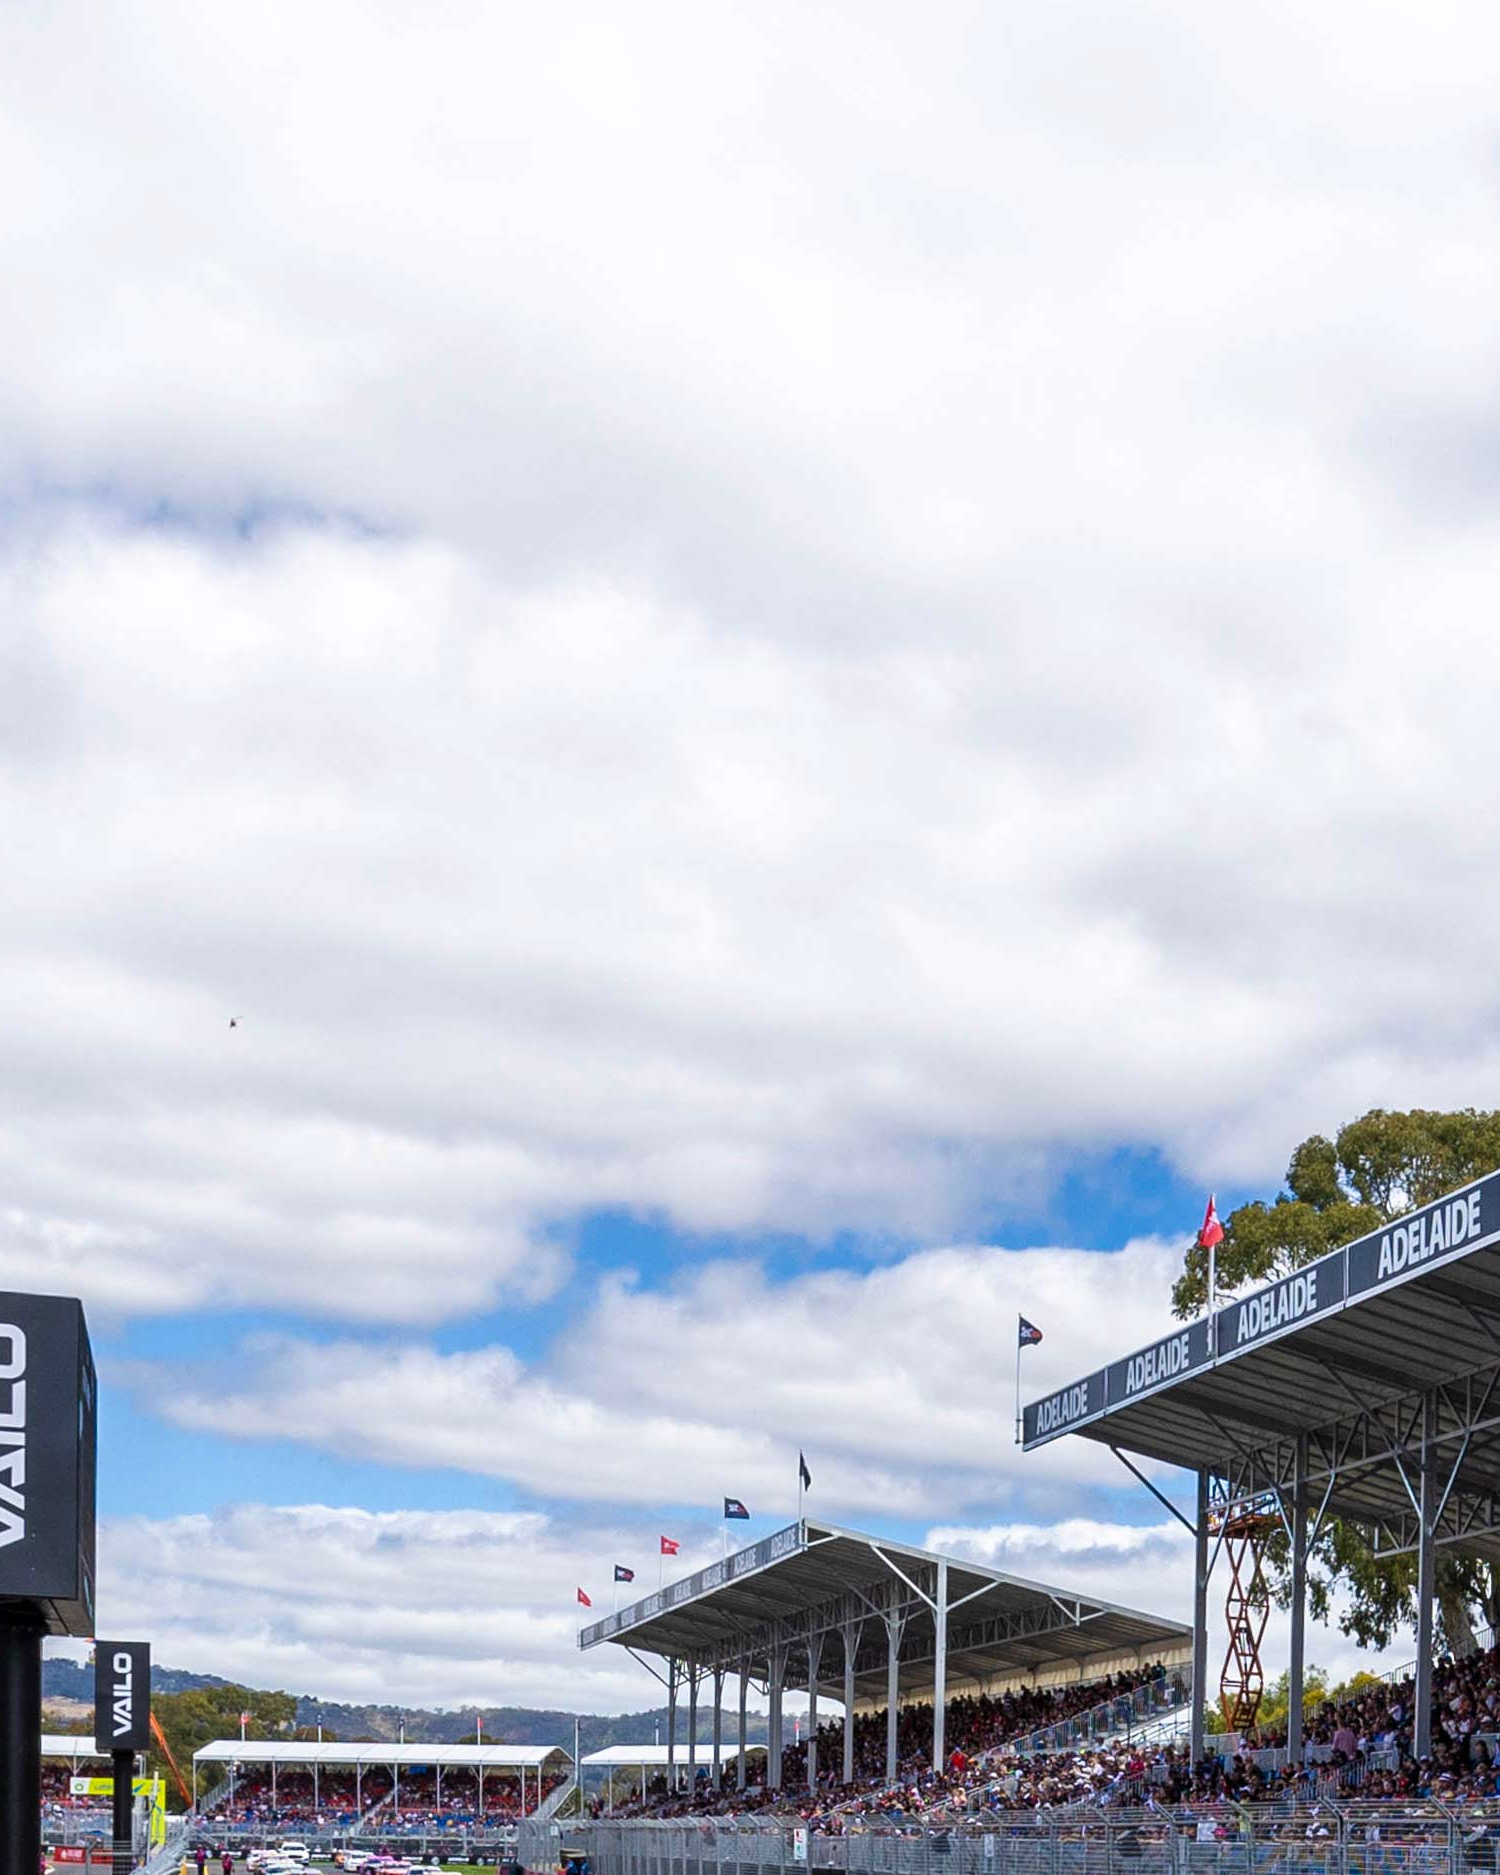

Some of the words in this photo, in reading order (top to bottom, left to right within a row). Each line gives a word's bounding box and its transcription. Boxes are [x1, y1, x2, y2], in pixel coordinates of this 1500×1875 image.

[1377, 1189, 1481, 1279] ADELAIDE
[1237, 1270, 1316, 1343] ADELAIDE
[1125, 1333, 1189, 1394] ADELAIDE
[1036, 1383, 1088, 1435] ADELAIDE
[113, 1653, 132, 1737] VAILO
